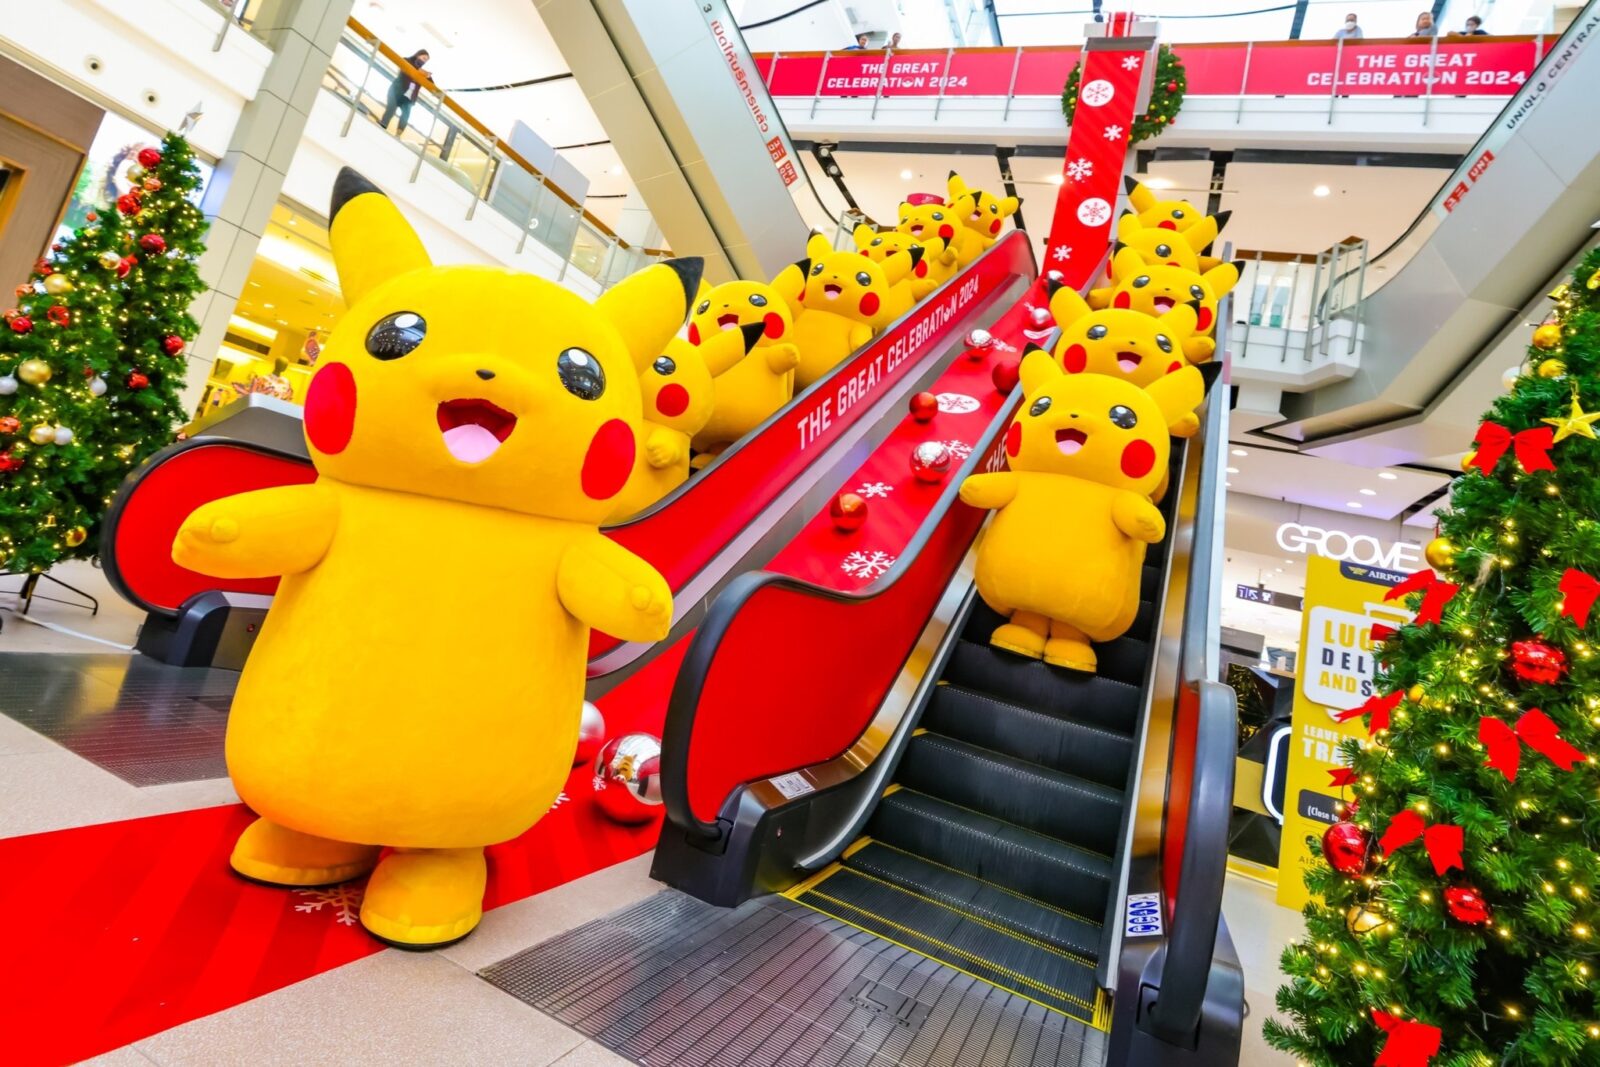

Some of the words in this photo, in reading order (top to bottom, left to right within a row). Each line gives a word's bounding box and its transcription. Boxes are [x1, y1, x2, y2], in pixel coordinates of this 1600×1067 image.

[861, 63, 886, 74] THE
[892, 62, 939, 74] GREAT
[1356, 54, 1397, 68] THE
[1404, 53, 1478, 68] GREAT
[1464, 70, 1526, 86] 2024
[1506, 81, 1547, 130] UNIQLO
[1547, 16, 1600, 79] CENTRAL
[797, 397, 832, 451] THE
[837, 354, 884, 417] GREAT
[958, 274, 979, 309] 2024
[1276, 522, 1421, 573] GROOVE
[1319, 671, 1357, 693] AND
